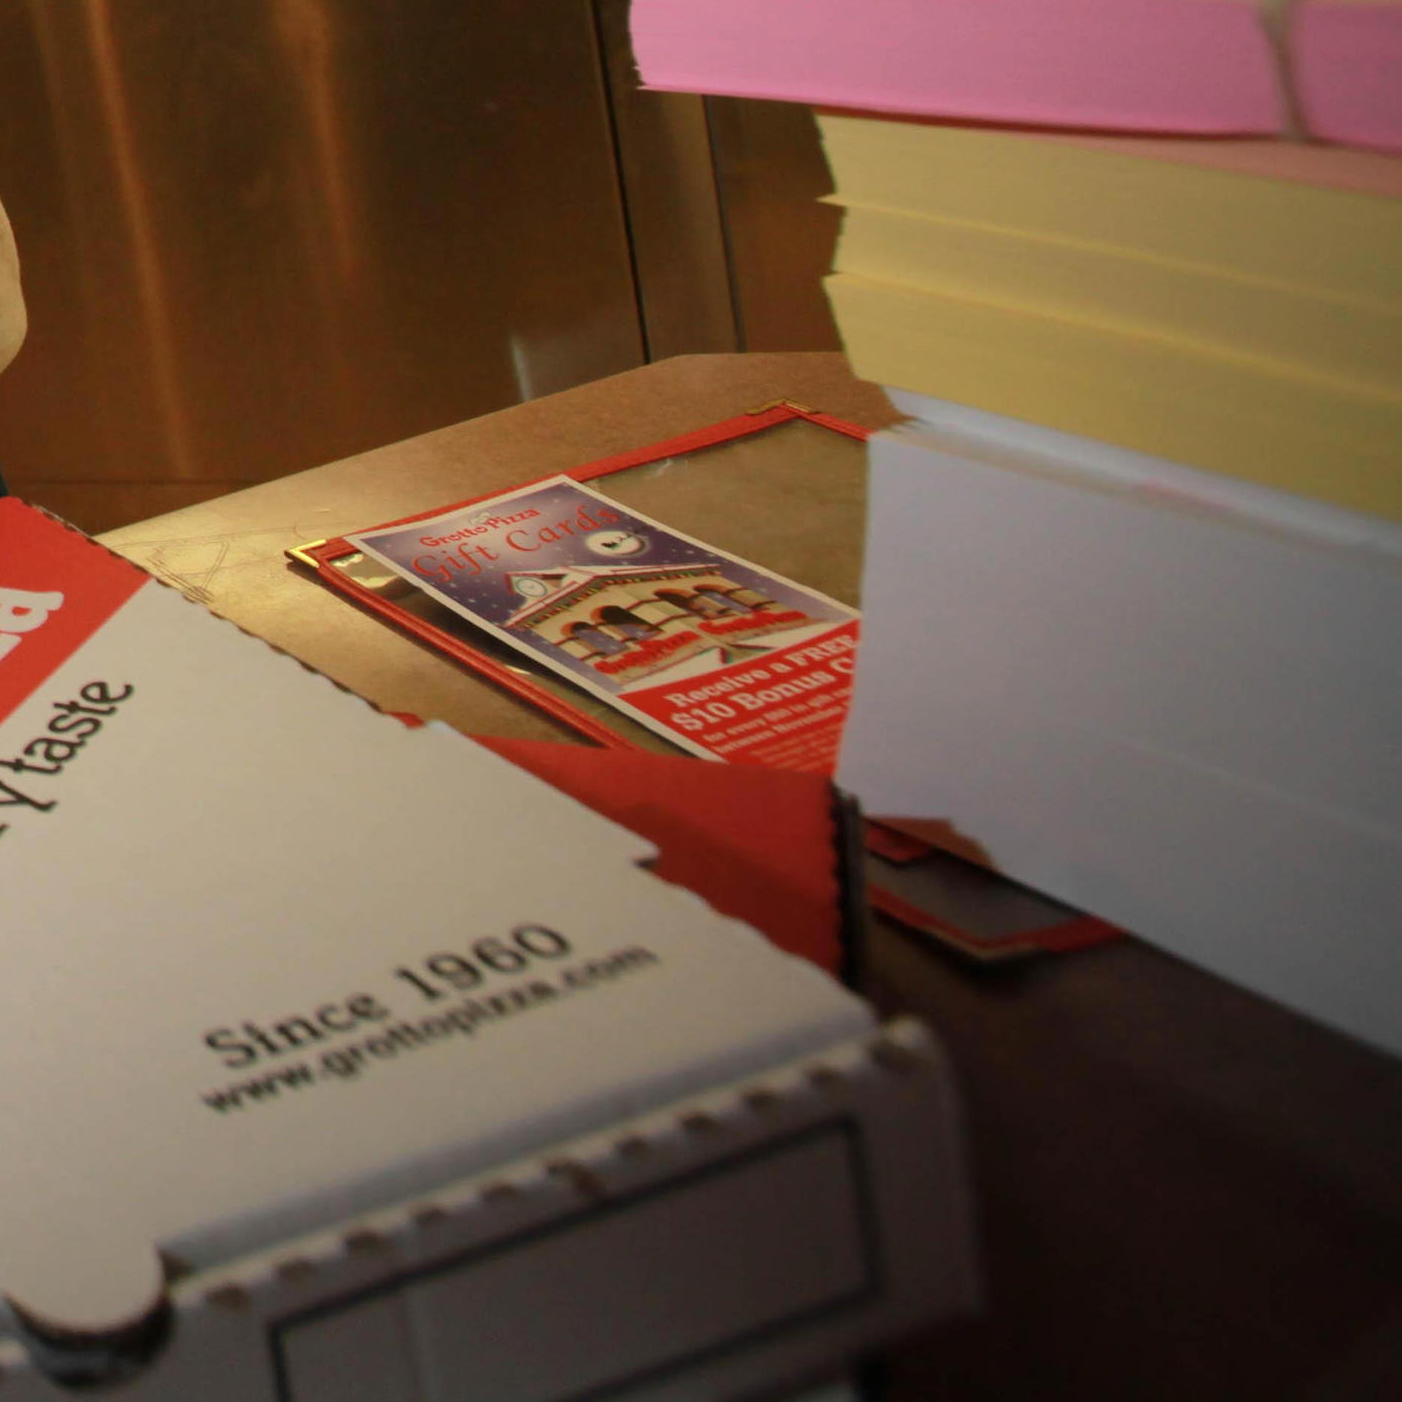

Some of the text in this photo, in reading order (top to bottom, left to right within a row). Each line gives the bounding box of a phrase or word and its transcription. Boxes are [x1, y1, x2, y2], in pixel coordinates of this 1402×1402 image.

[412, 504, 621, 583] Gift Cards
[419, 507, 541, 548] Grotto Pizza
[664, 634, 856, 708] Receive a FREE
[670, 701, 738, 732] $10
[727, 670, 837, 711] Bonus
[9, 672, 135, 779] taste
[201, 944, 660, 1116] www.grottopizza.com
[203, 922, 573, 1070] Since 1960
